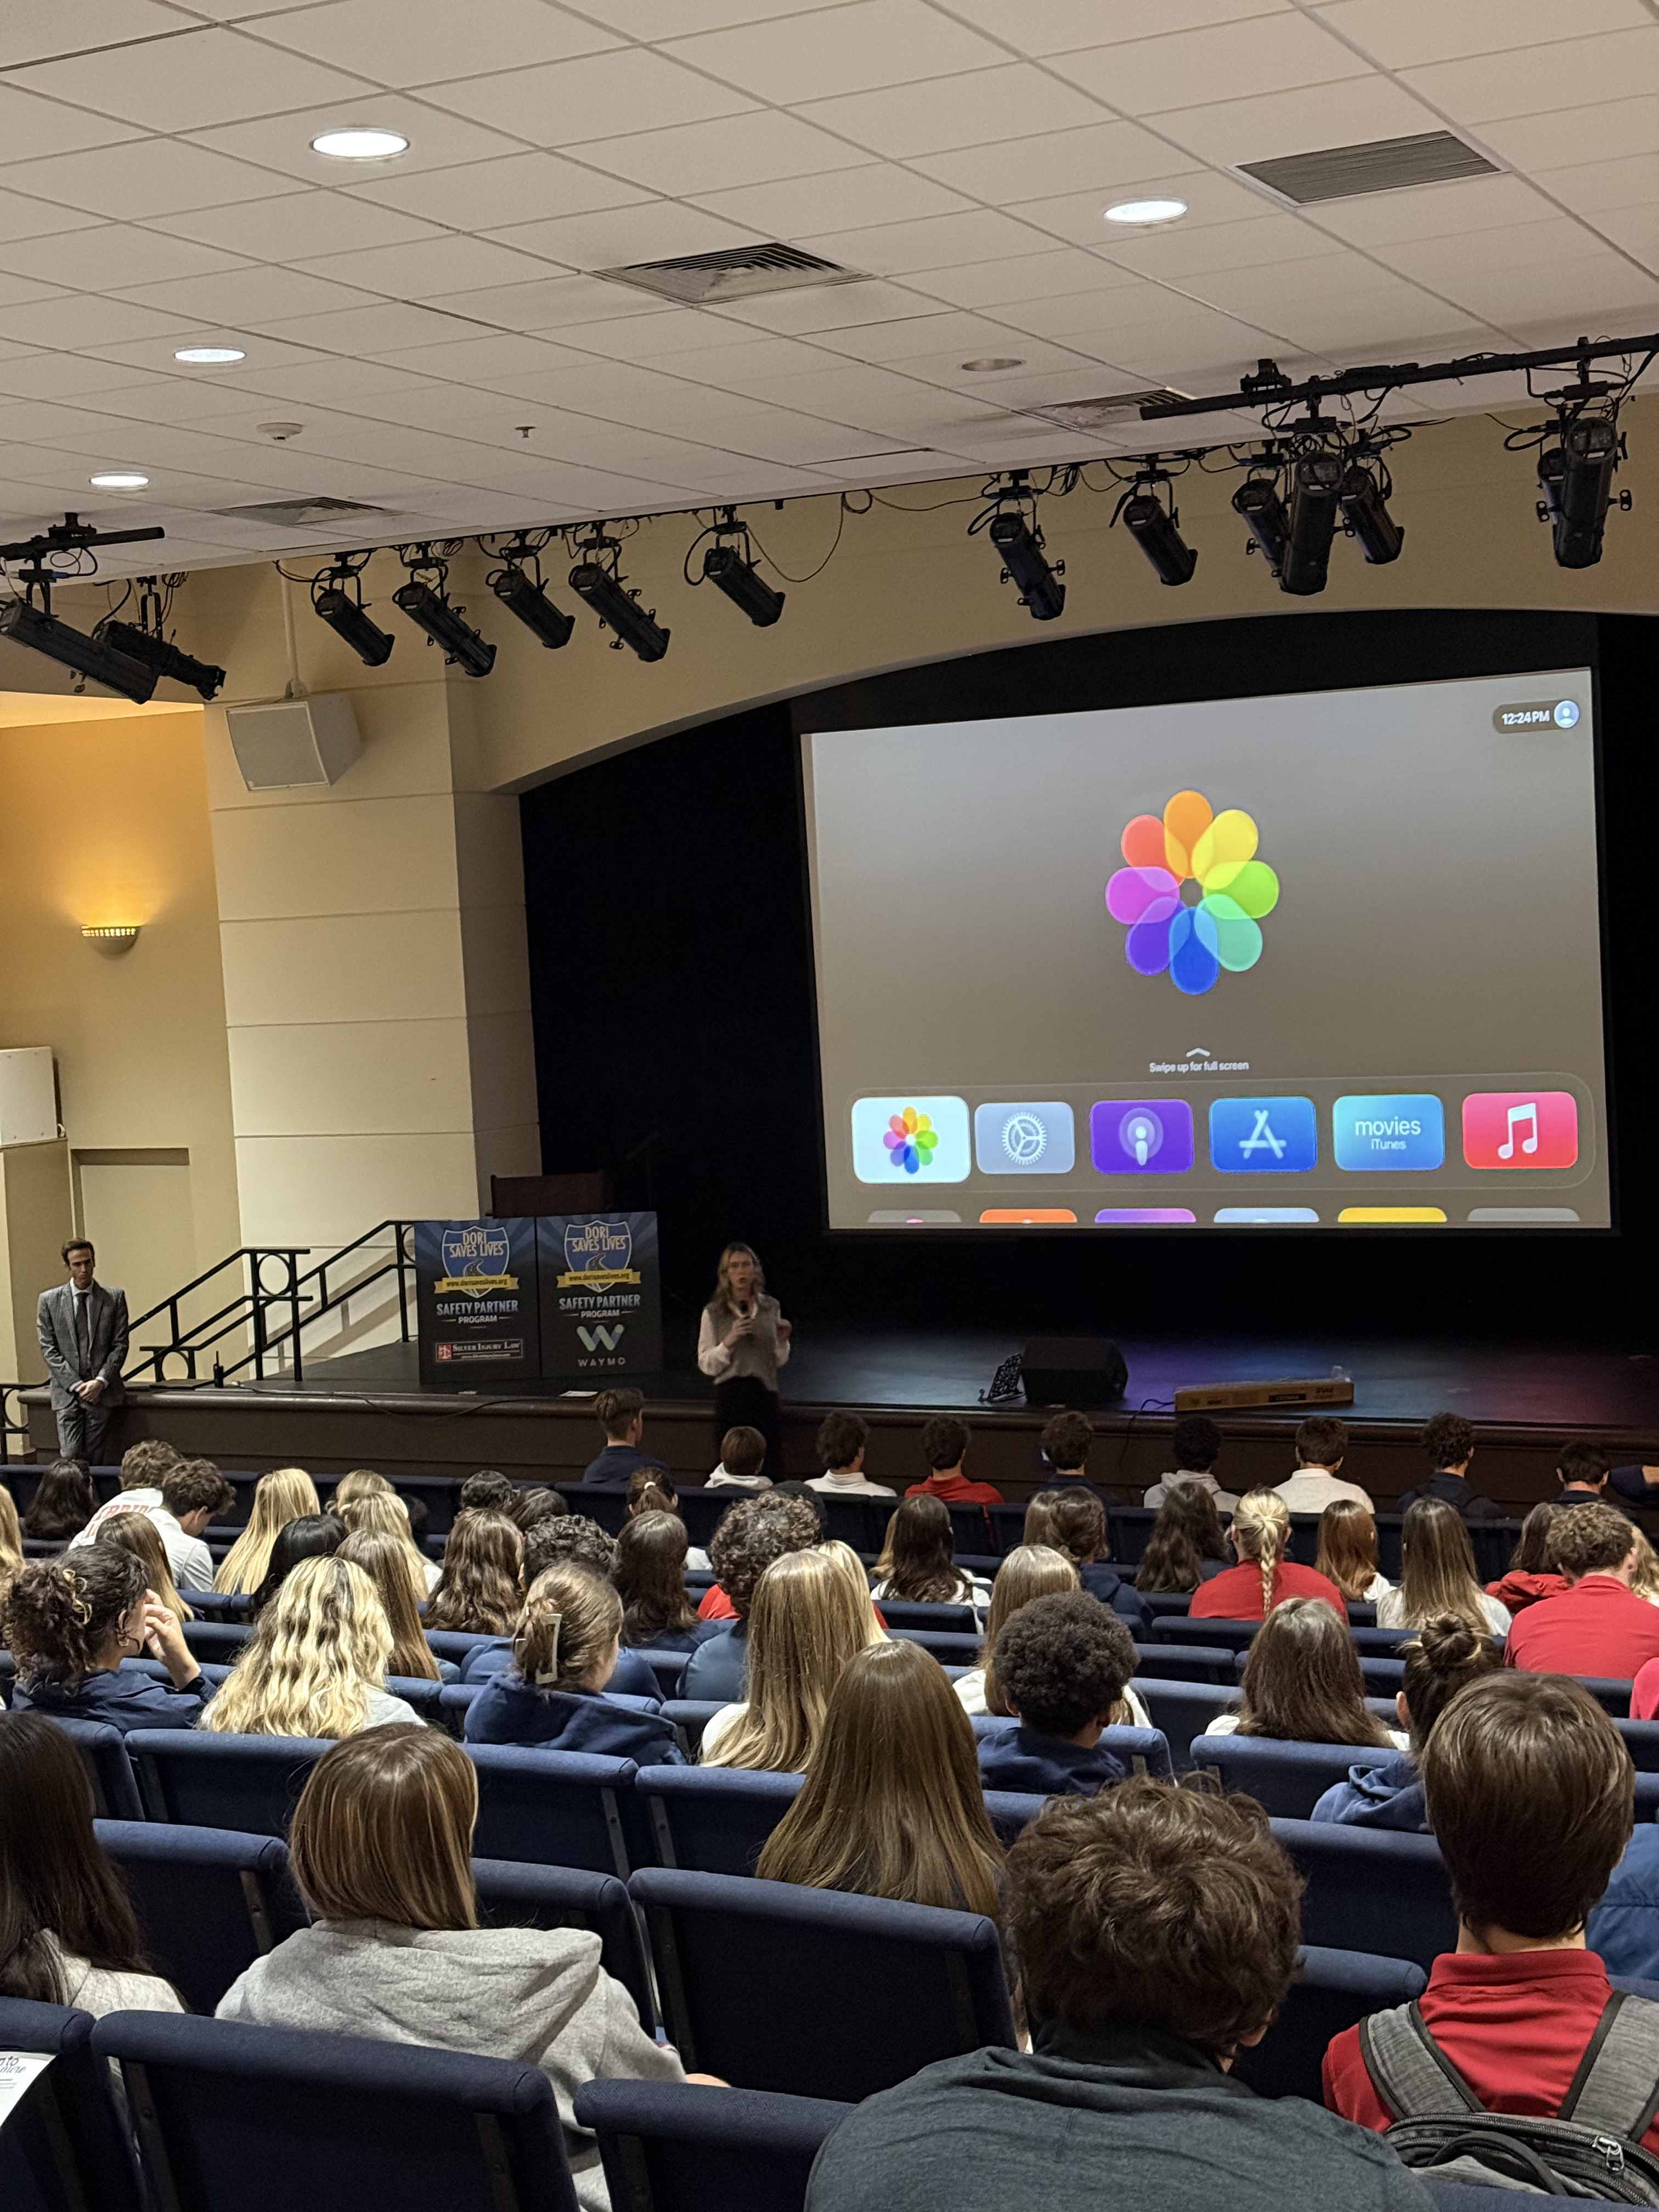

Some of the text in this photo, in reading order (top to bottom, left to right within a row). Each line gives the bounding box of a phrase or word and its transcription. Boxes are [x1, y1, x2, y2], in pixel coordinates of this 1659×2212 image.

[1149, 1060, 1249, 1074] Swipe up for full screen
[1355, 1115, 1421, 1136] movies
[1372, 1138, 1407, 1150] iTunes
[462, 1232, 487, 1245] DORI
[585, 1226, 609, 1239] DORI
[449, 1243, 504, 1258] SAVES LIVES
[572, 1237, 626, 1252] SAVES LIVES
[436, 1300, 518, 1316] SAFETY PARTNER
[558, 1294, 641, 1310] SAFETY PARTNER
[458, 1315, 498, 1324] PROGRAM
[580, 1310, 620, 1318] PROGRAM
[578, 1357, 626, 1367] WAYMO
